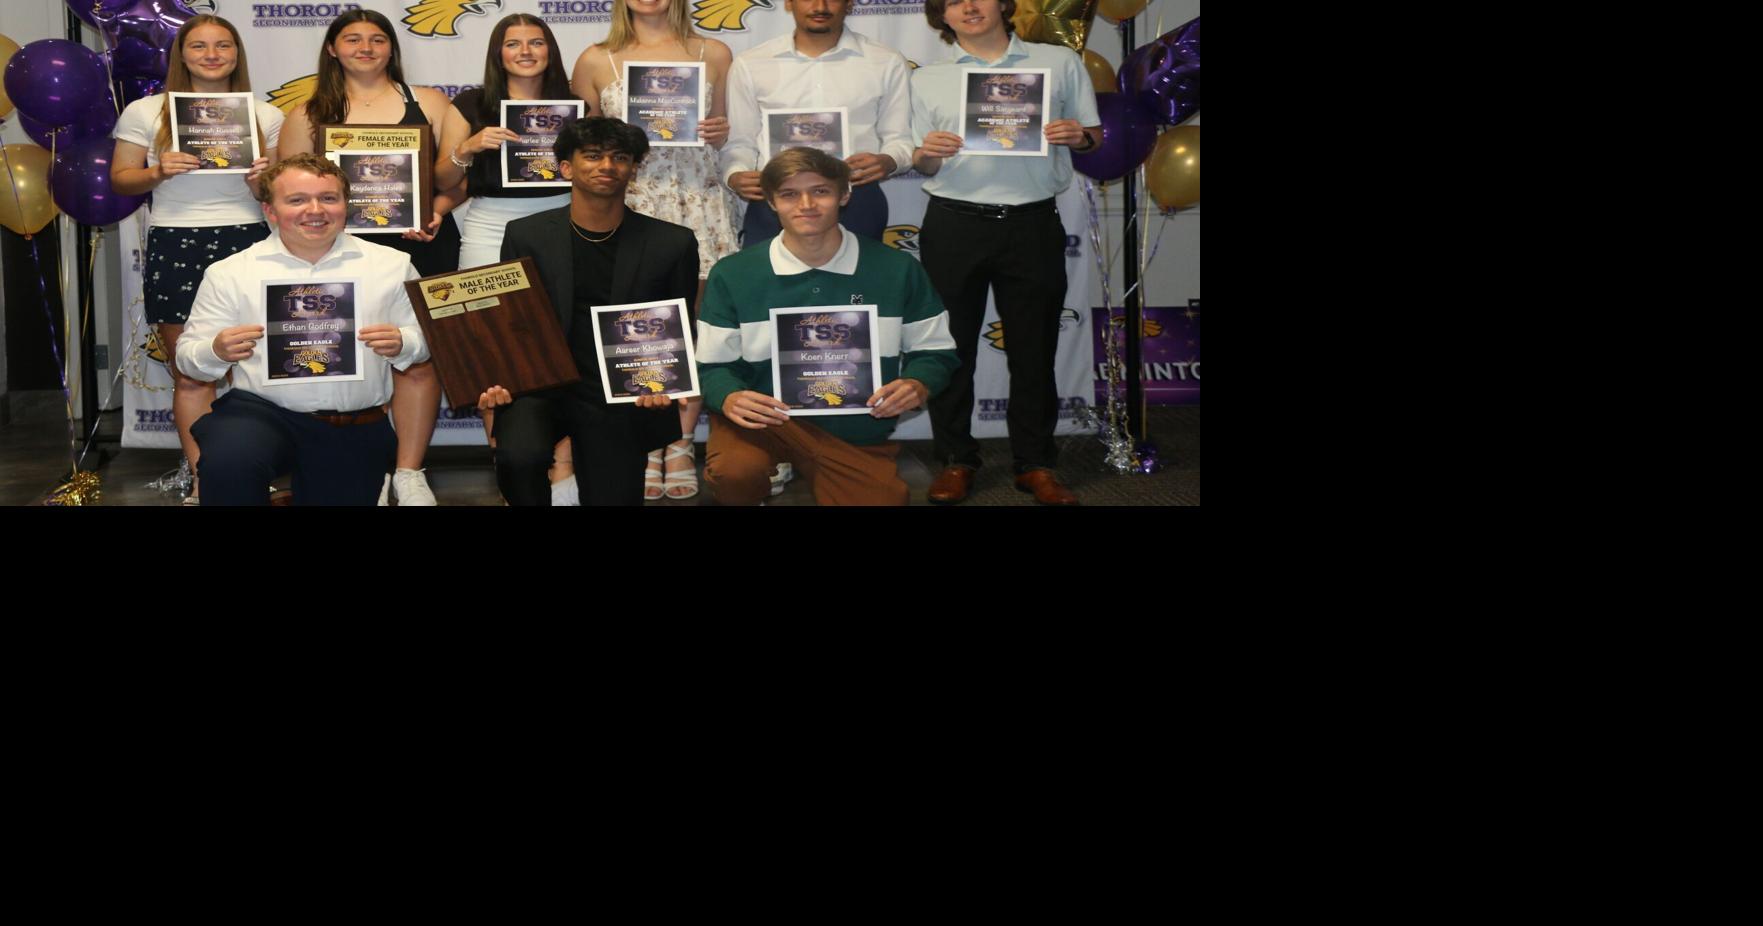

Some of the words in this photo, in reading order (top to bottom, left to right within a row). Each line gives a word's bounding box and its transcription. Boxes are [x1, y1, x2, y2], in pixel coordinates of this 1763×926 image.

[539, 0, 613, 13] THORO
[641, 75, 684, 89] TSS
[982, 82, 1027, 96] TSS
[520, 114, 563, 129] TSS
[784, 121, 828, 136] TSS
[353, 163, 397, 177] TSS
[459, 279, 483, 290] MALE
[485, 271, 522, 284] ATHLETE
[467, 286, 478, 295] OF
[480, 282, 496, 292] THE
[497, 279, 519, 289] YEAR
[283, 294, 336, 312] TSS
[282, 323, 306, 332] Ethan
[615, 317, 665, 336] TSS
[794, 323, 851, 342] TSS
[801, 352, 823, 361] Koen
